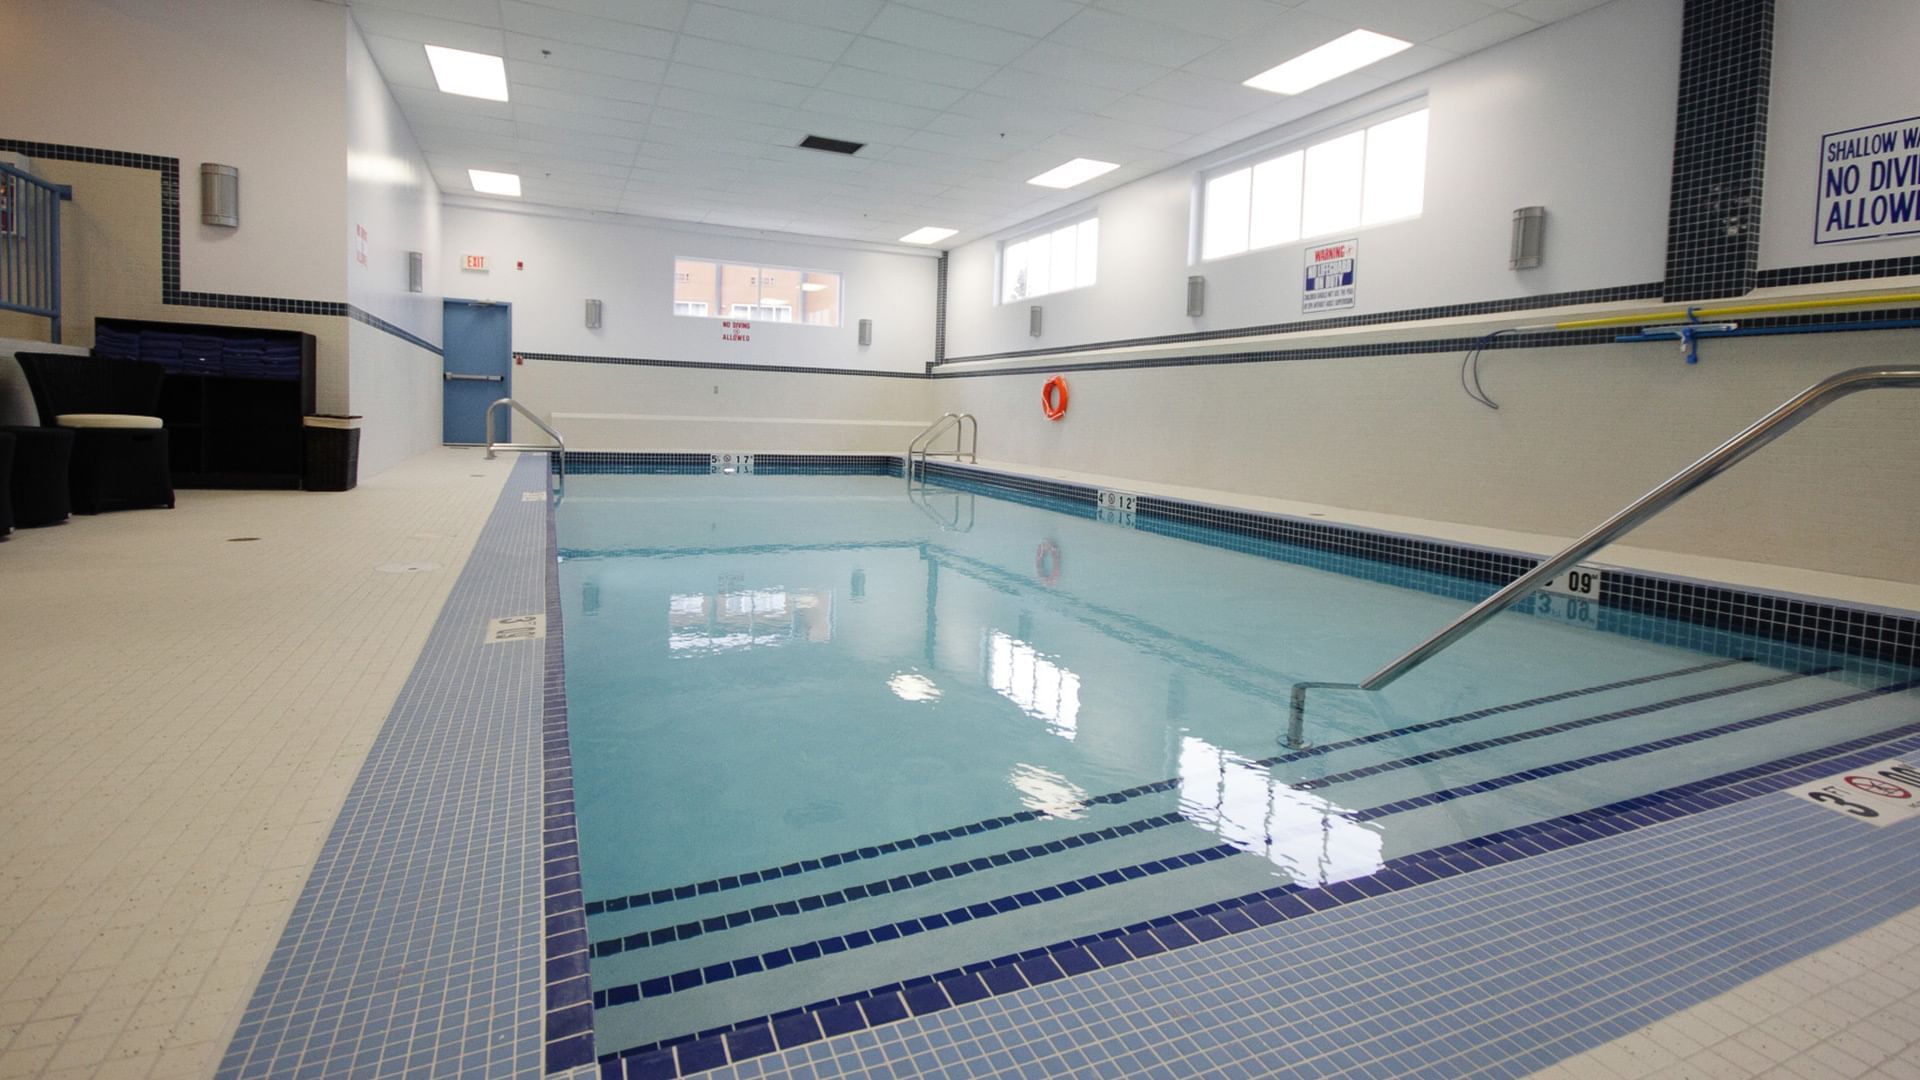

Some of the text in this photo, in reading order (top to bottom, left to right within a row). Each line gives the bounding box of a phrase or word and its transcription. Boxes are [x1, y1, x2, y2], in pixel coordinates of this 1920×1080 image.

[1828, 127, 1920, 162] SHALLOW W
[1826, 154, 1920, 198] NO DIVI
[1826, 190, 1920, 231] ALLOW
[467, 255, 484, 268] EXIT
[1315, 245, 1345, 262] WARNING
[711, 455, 718, 463] 5
[1098, 493, 1103, 504] 4
[1808, 792, 1879, 817] 3
